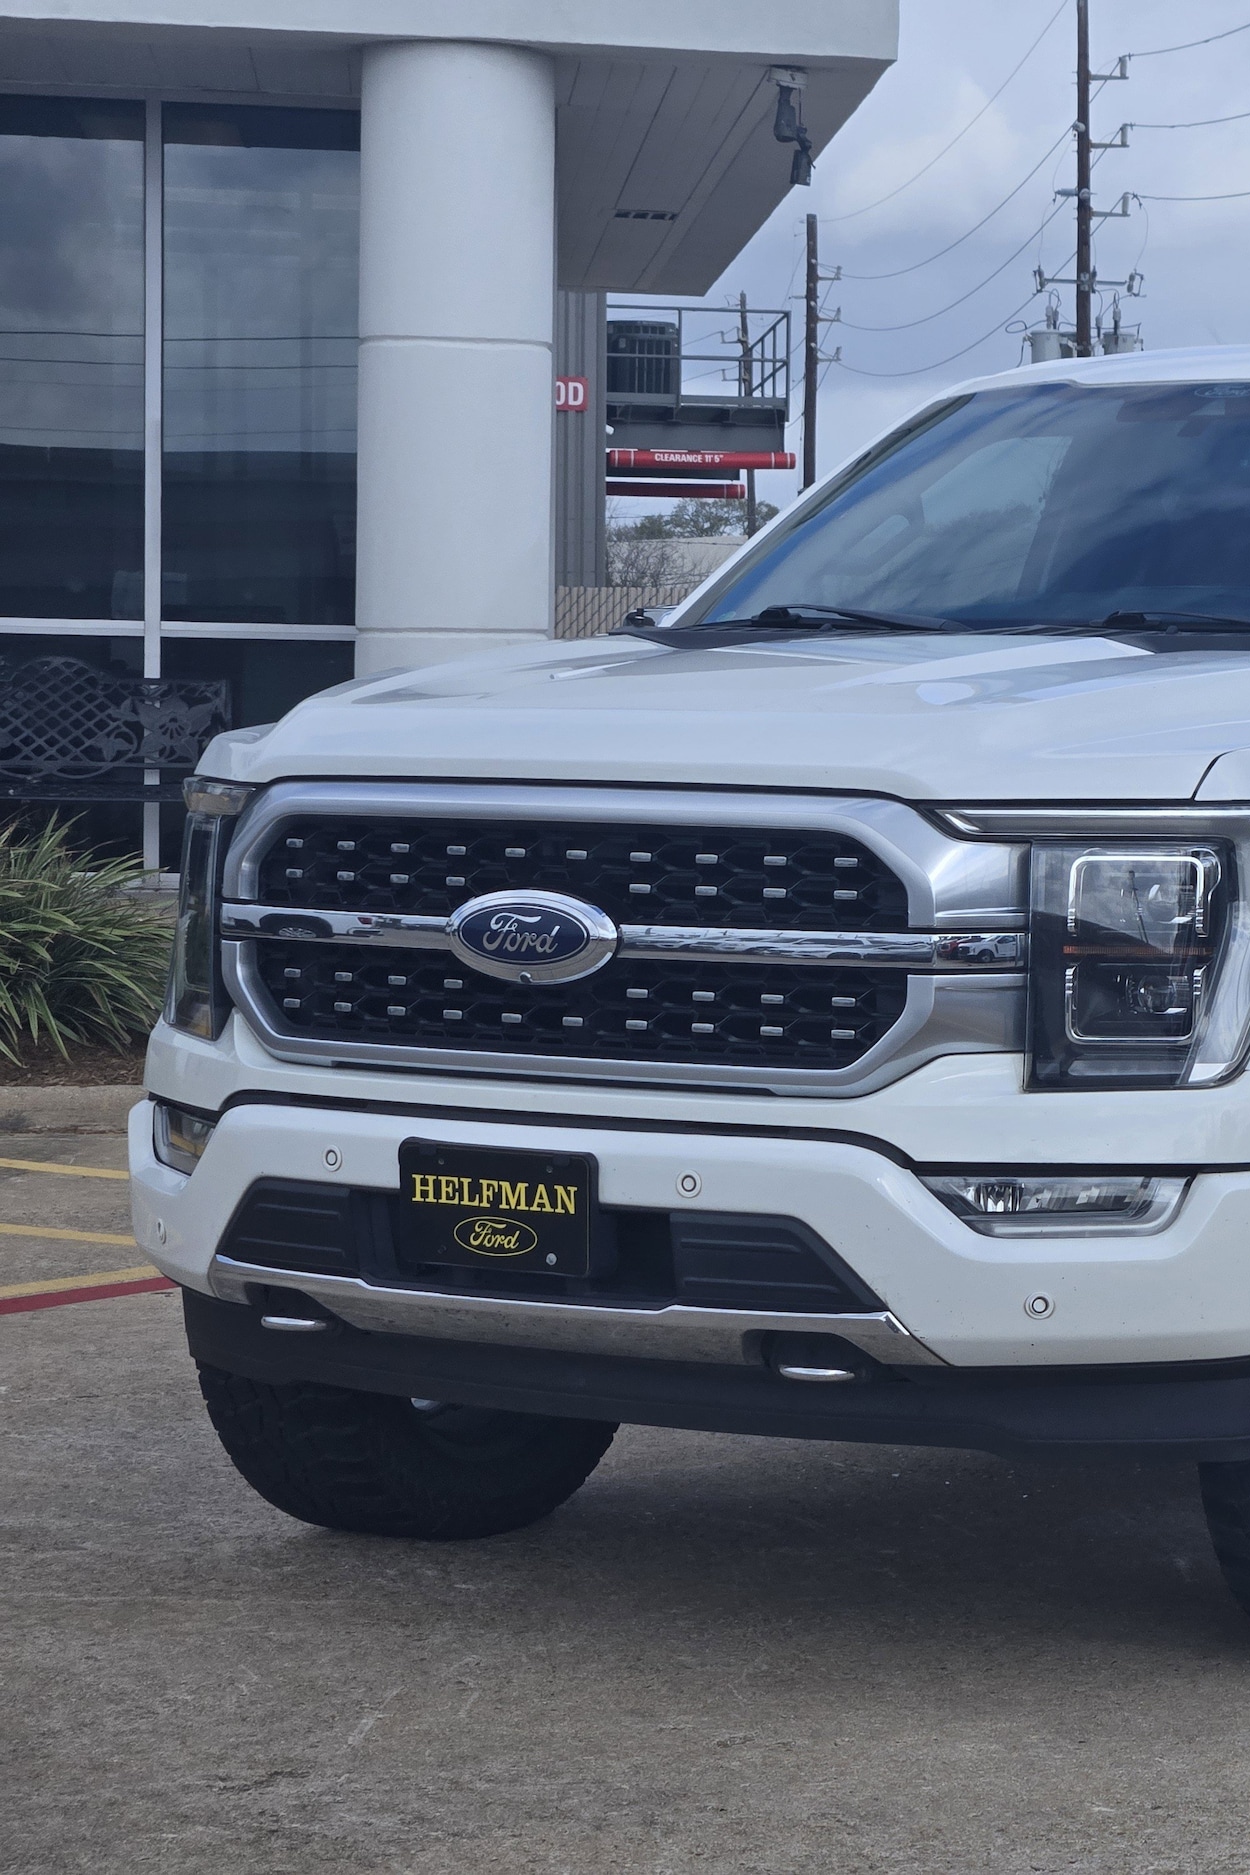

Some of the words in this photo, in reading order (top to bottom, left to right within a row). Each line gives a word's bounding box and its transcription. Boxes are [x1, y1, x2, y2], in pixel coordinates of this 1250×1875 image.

[654, 453, 703, 463] CLEARANCE
[482, 912, 561, 954] Ford
[411, 1173, 578, 1215] HELFMAN
[469, 1220, 521, 1250] Ford
